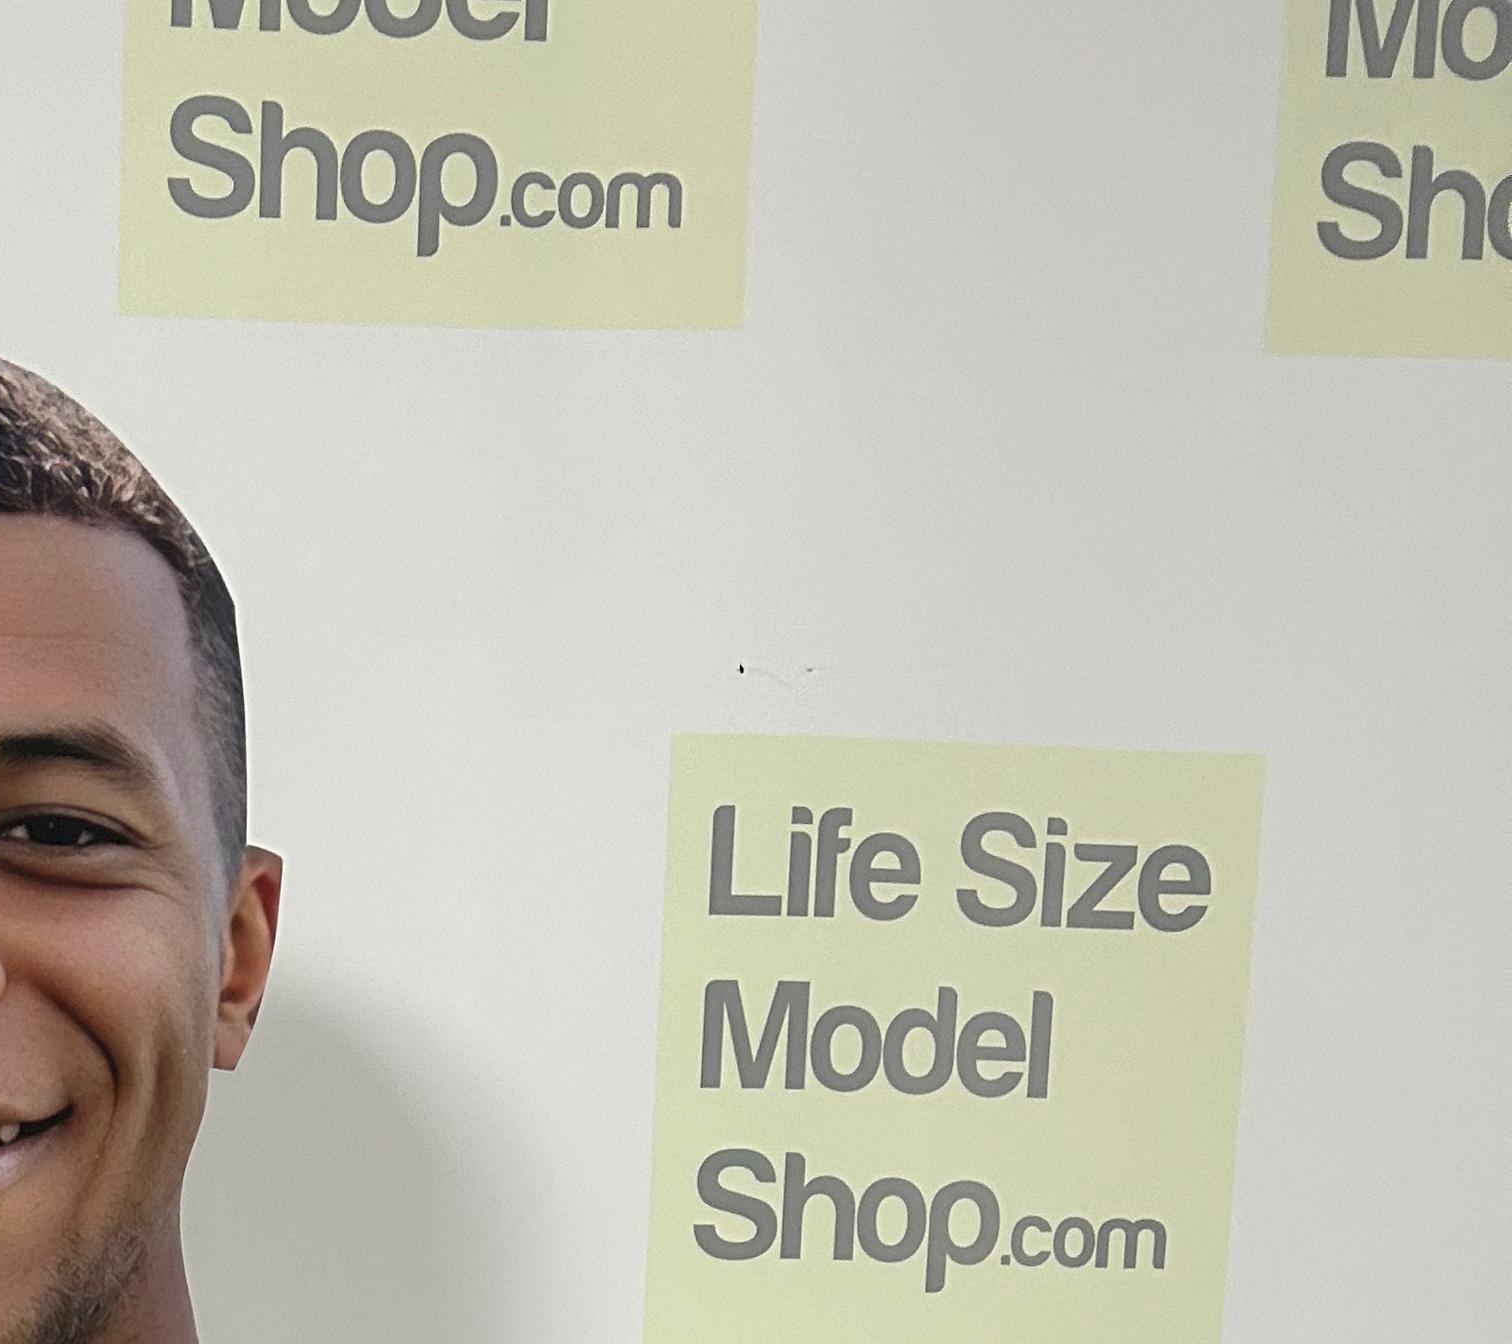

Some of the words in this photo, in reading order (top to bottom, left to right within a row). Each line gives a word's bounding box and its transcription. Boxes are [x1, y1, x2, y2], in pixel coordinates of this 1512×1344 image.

[168, 95, 683, 257] Shop.com
[709, 805, 921, 921] Life
[956, 812, 1211, 932] Size
[700, 980, 1054, 1098] Model
[694, 1149, 1167, 1293] Shop.com
